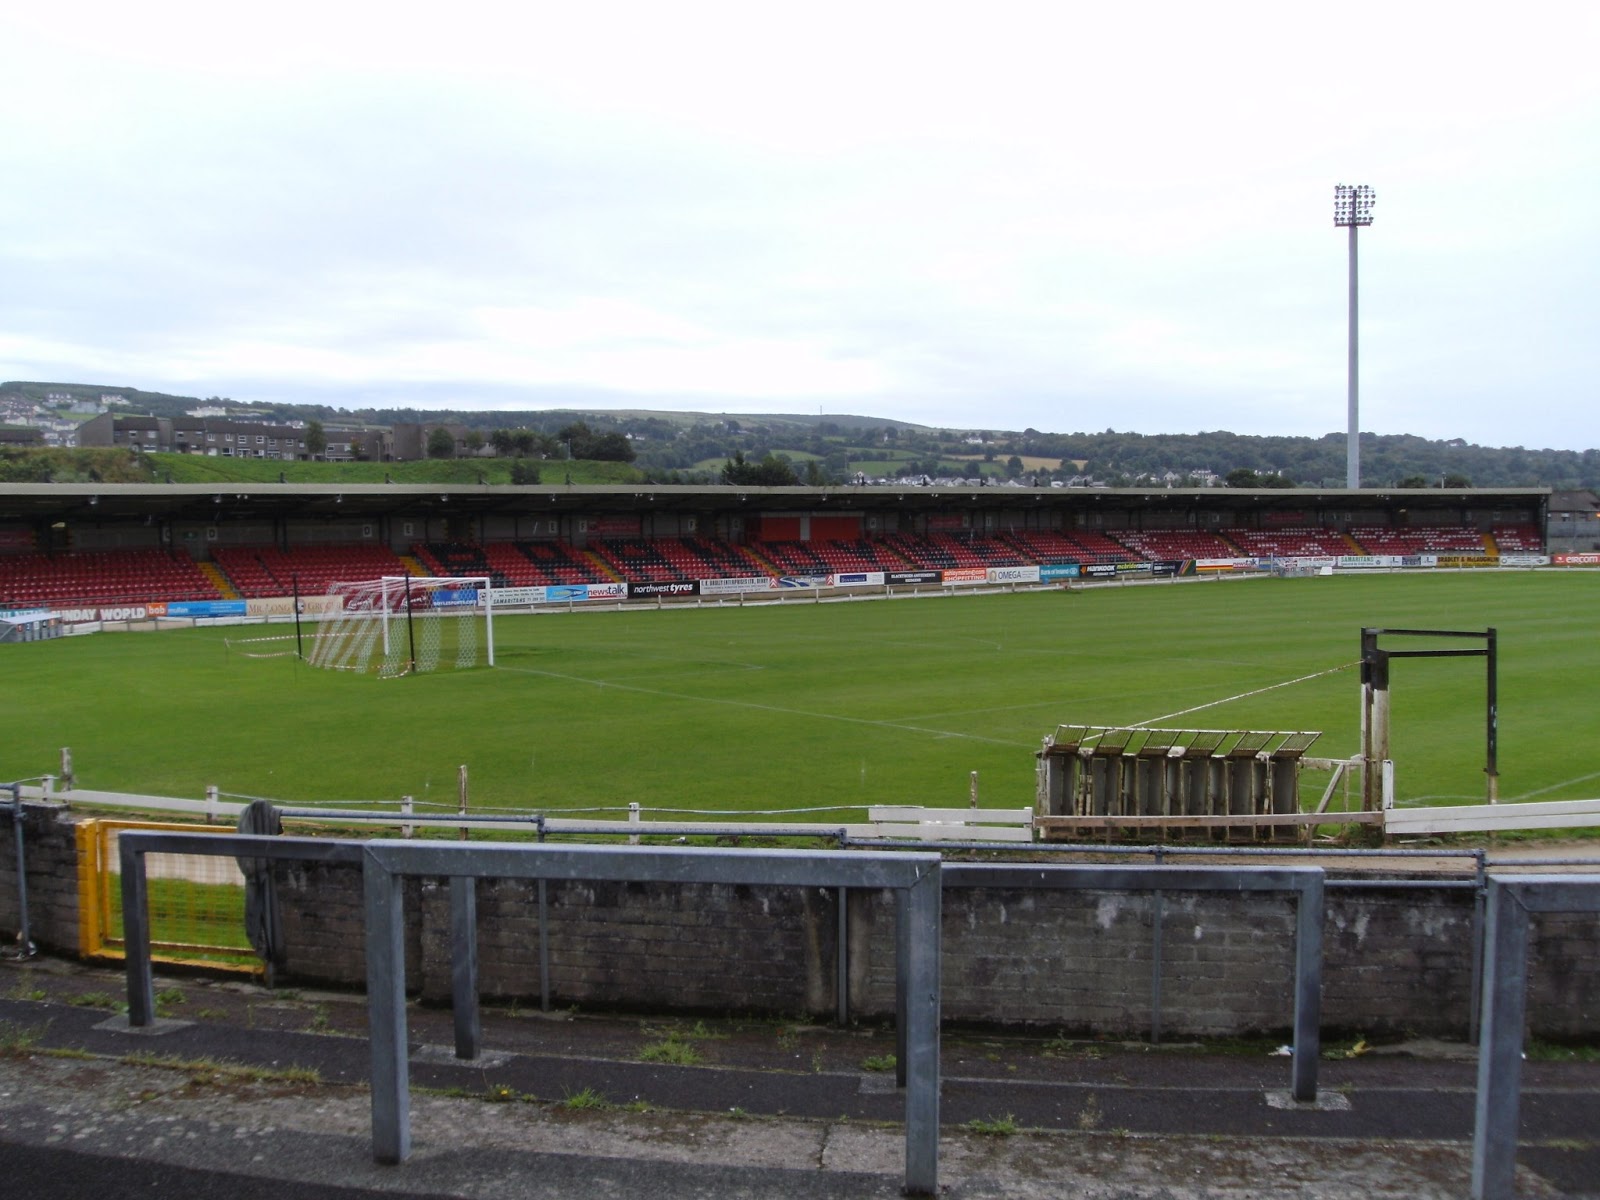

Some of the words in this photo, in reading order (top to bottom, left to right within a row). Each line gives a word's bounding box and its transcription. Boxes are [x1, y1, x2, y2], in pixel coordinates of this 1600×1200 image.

[998, 571, 1021, 579] OMEGA
[587, 586, 625, 596] newstalk
[634, 585, 669, 593] northwest
[670, 583, 693, 594] tyres
[51, 609, 96, 621] UNDAY
[100, 607, 146, 620] WORLD
[148, 606, 165, 614] bob
